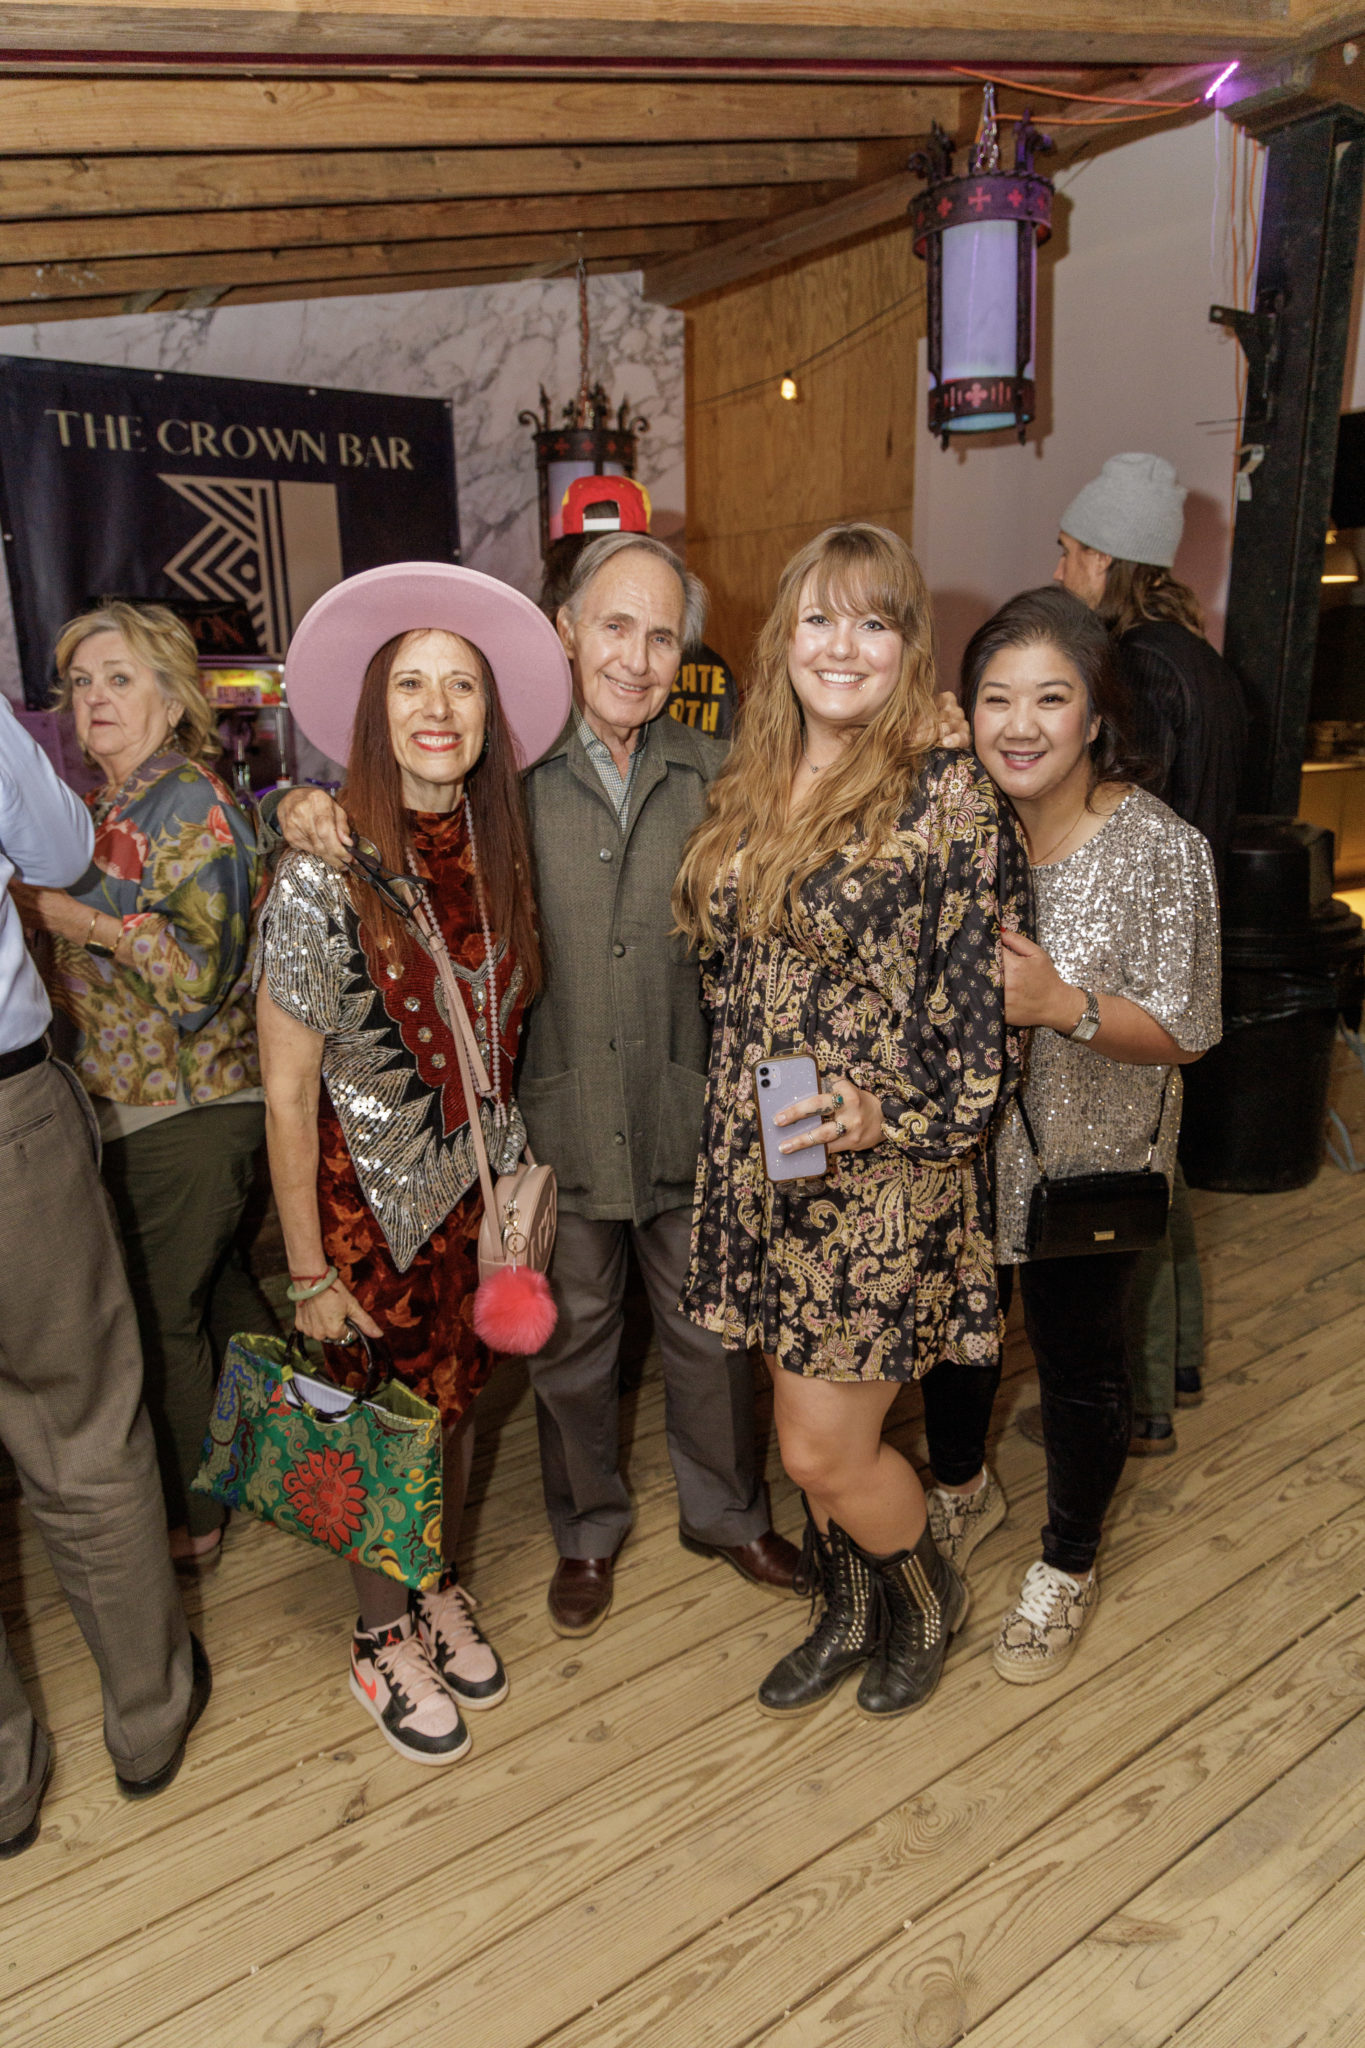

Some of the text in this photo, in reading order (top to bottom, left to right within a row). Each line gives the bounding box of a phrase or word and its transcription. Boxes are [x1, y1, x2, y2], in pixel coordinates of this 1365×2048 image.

[45, 409, 414, 470] THE CROWN BAR
